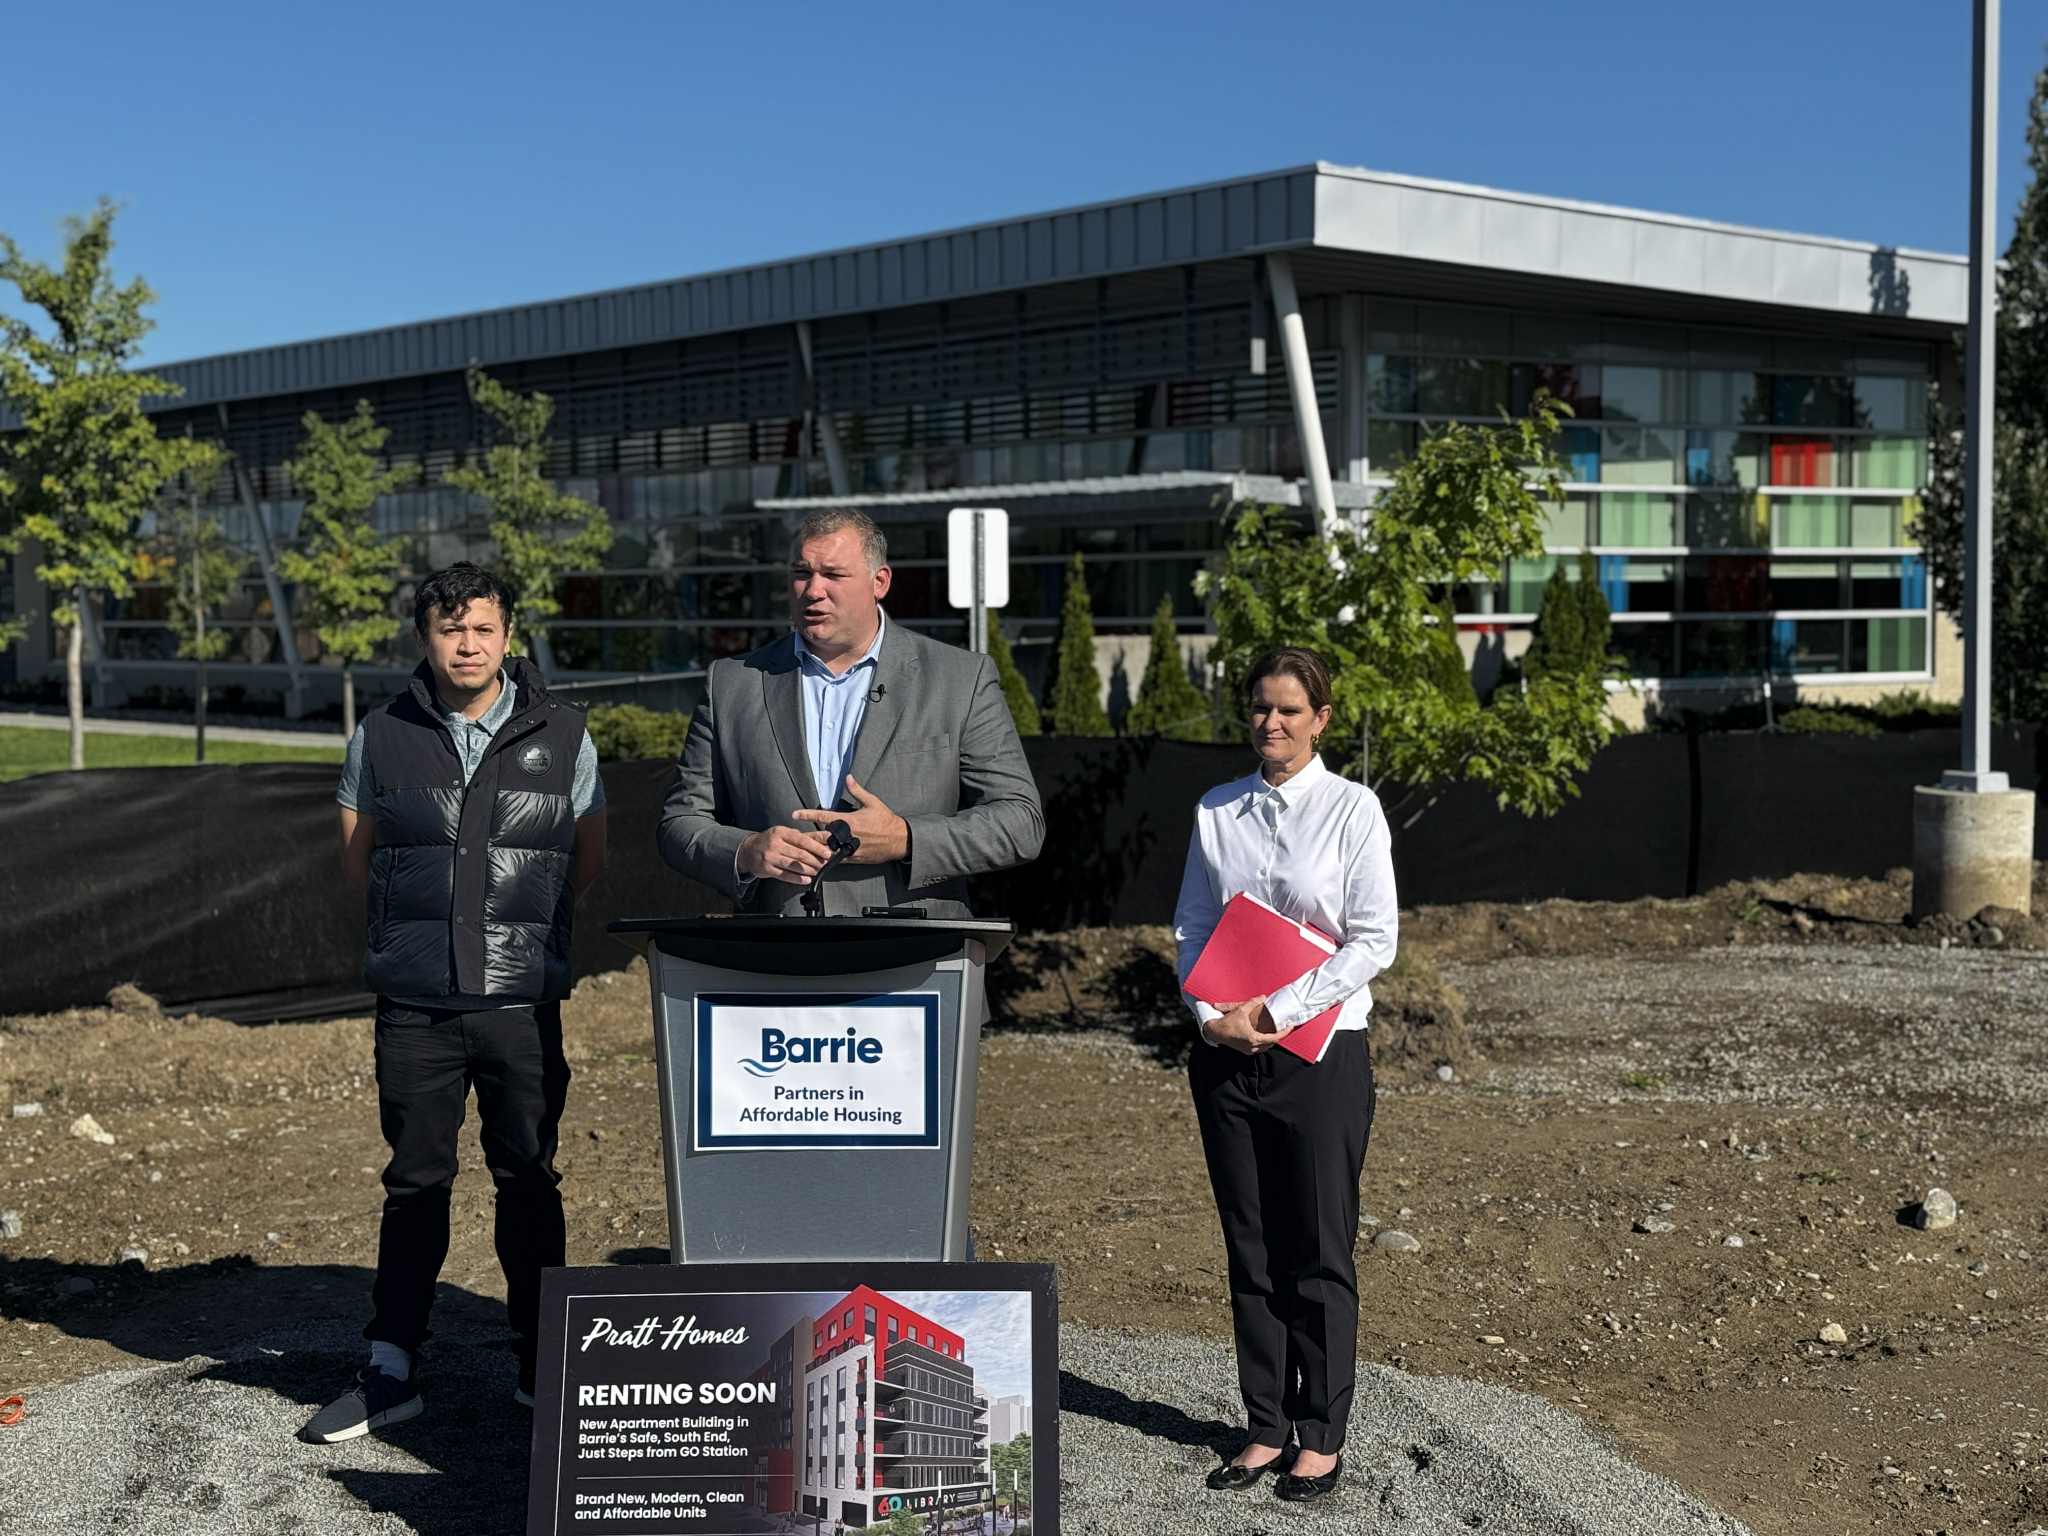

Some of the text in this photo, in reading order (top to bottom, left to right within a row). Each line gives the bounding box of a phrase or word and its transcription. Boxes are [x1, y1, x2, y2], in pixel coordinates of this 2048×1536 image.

[762, 1027, 883, 1064] Barrie
[774, 1086, 863, 1100] Partners in
[740, 1107, 902, 1124] Affordable Housing
[581, 1315, 749, 1351] Pratt Homes
[578, 1383, 776, 1406] RENTING SOON
[580, 1416, 749, 1431] New Apartment Building in
[630, 1432, 661, 1444] Safe,
[664, 1432, 701, 1442] South
[704, 1431, 730, 1443] End,
[578, 1446, 748, 1461] Just Steps from GO Station
[576, 1492, 744, 1505] Brand New, Modern, Clean
[575, 1507, 707, 1520] and Affordable Units
